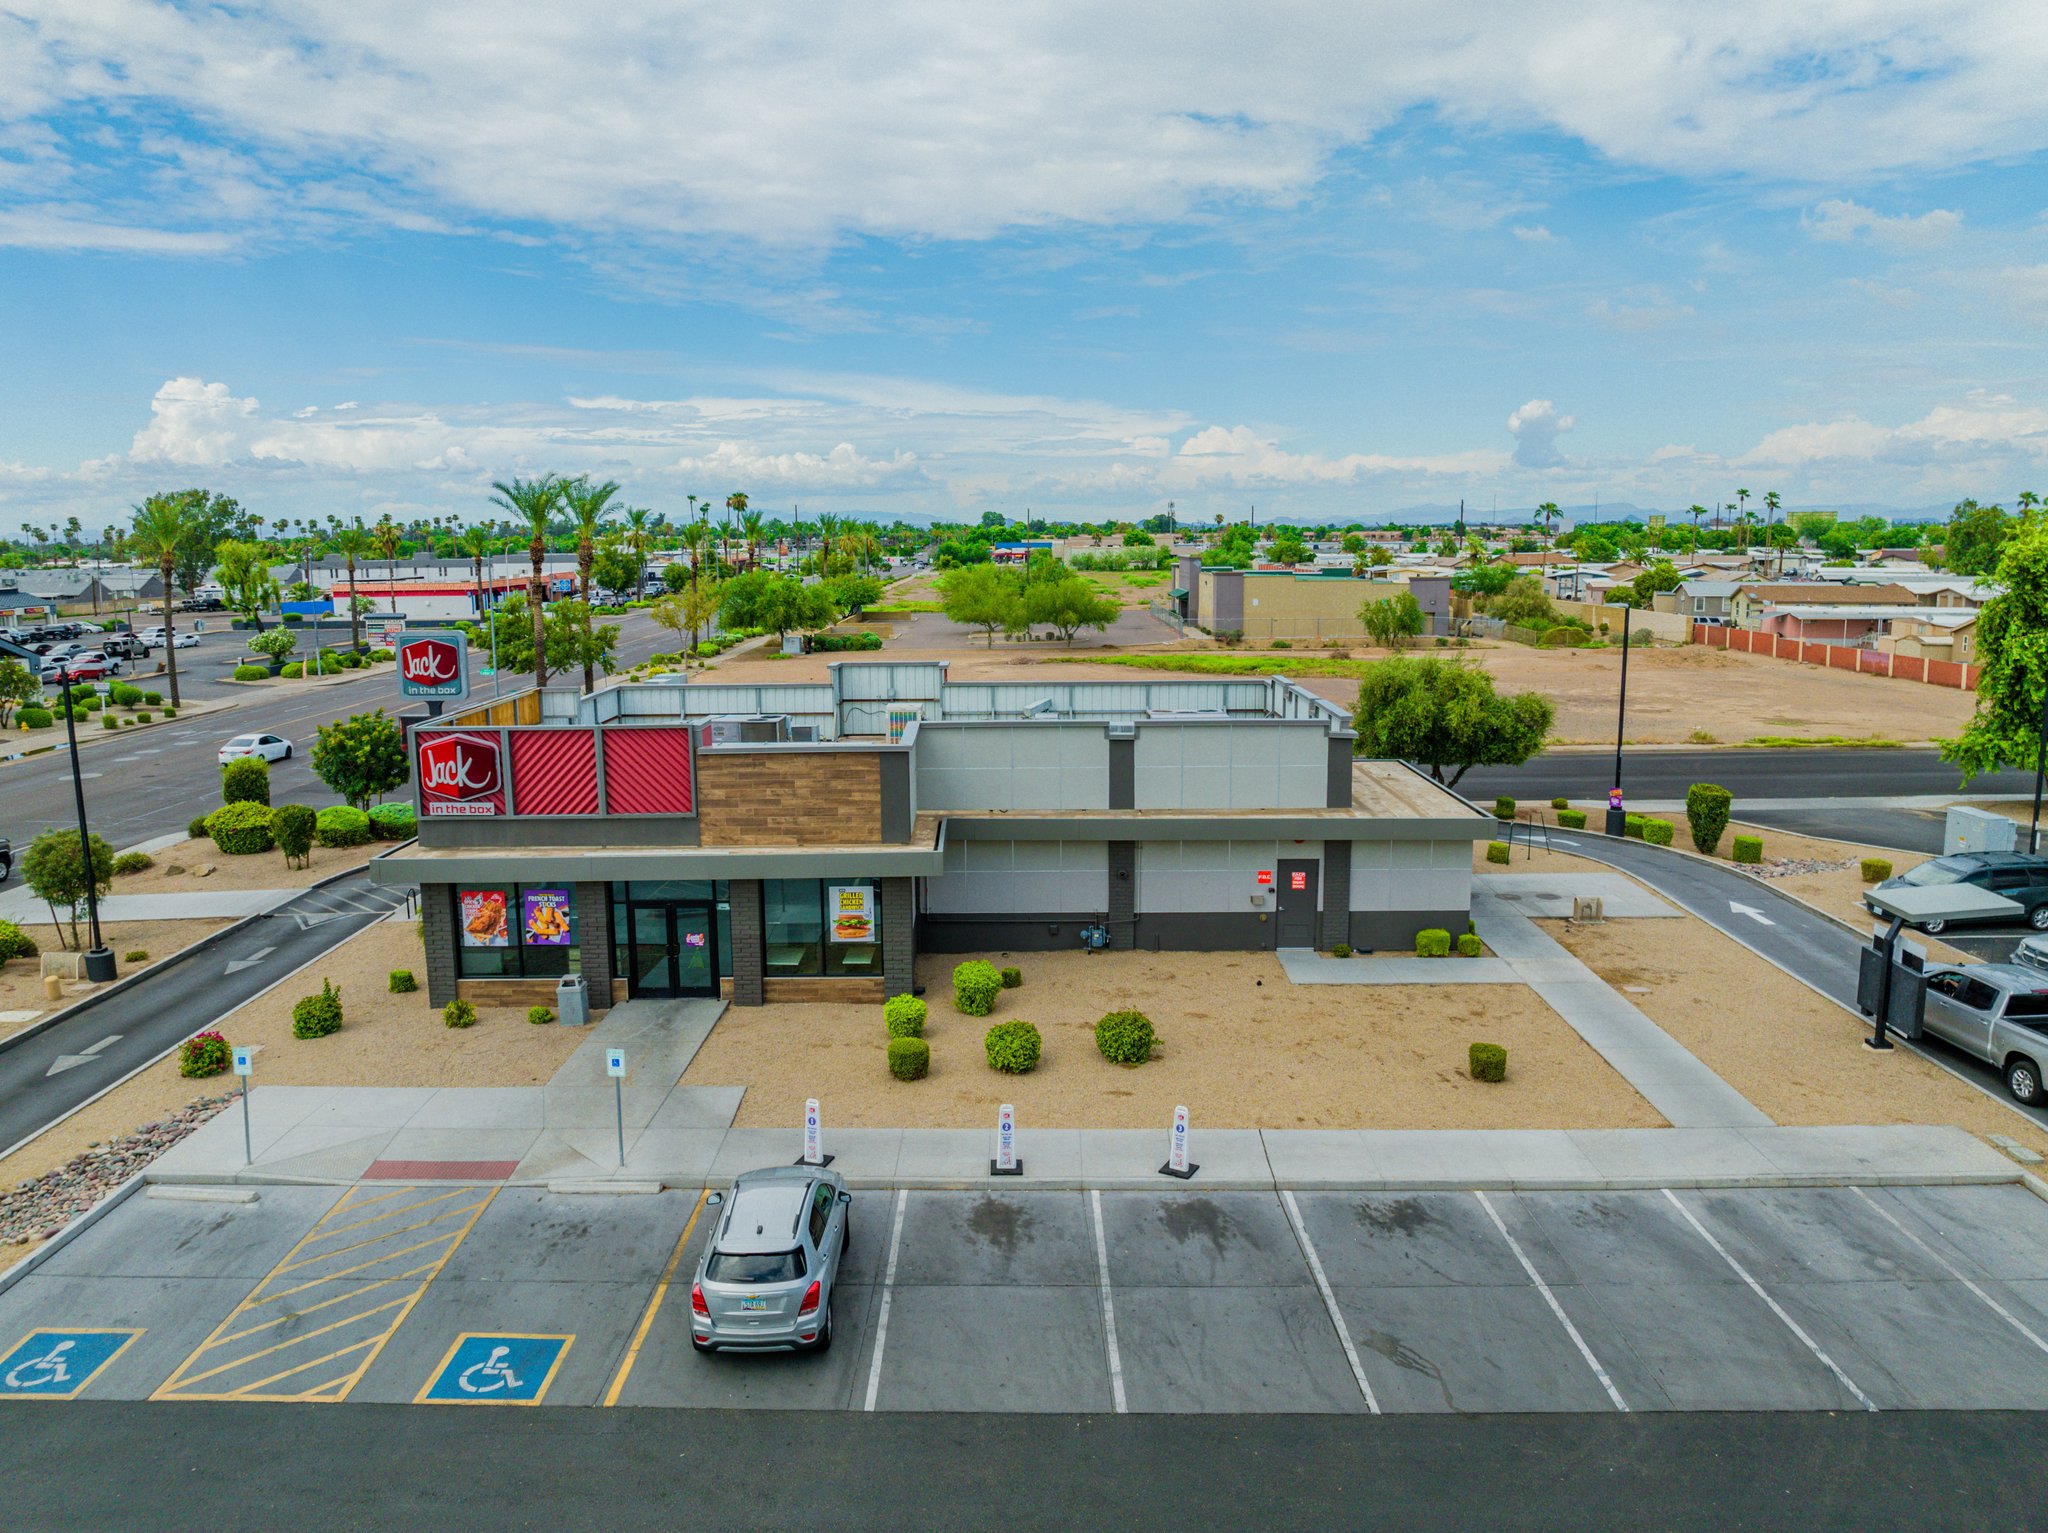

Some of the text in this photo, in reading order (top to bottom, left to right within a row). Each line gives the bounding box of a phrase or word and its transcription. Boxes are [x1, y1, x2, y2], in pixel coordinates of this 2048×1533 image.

[405, 645, 456, 679] Jack
[408, 686, 456, 695] in the box
[425, 745, 492, 789] Jack
[431, 804, 493, 814] in the box
